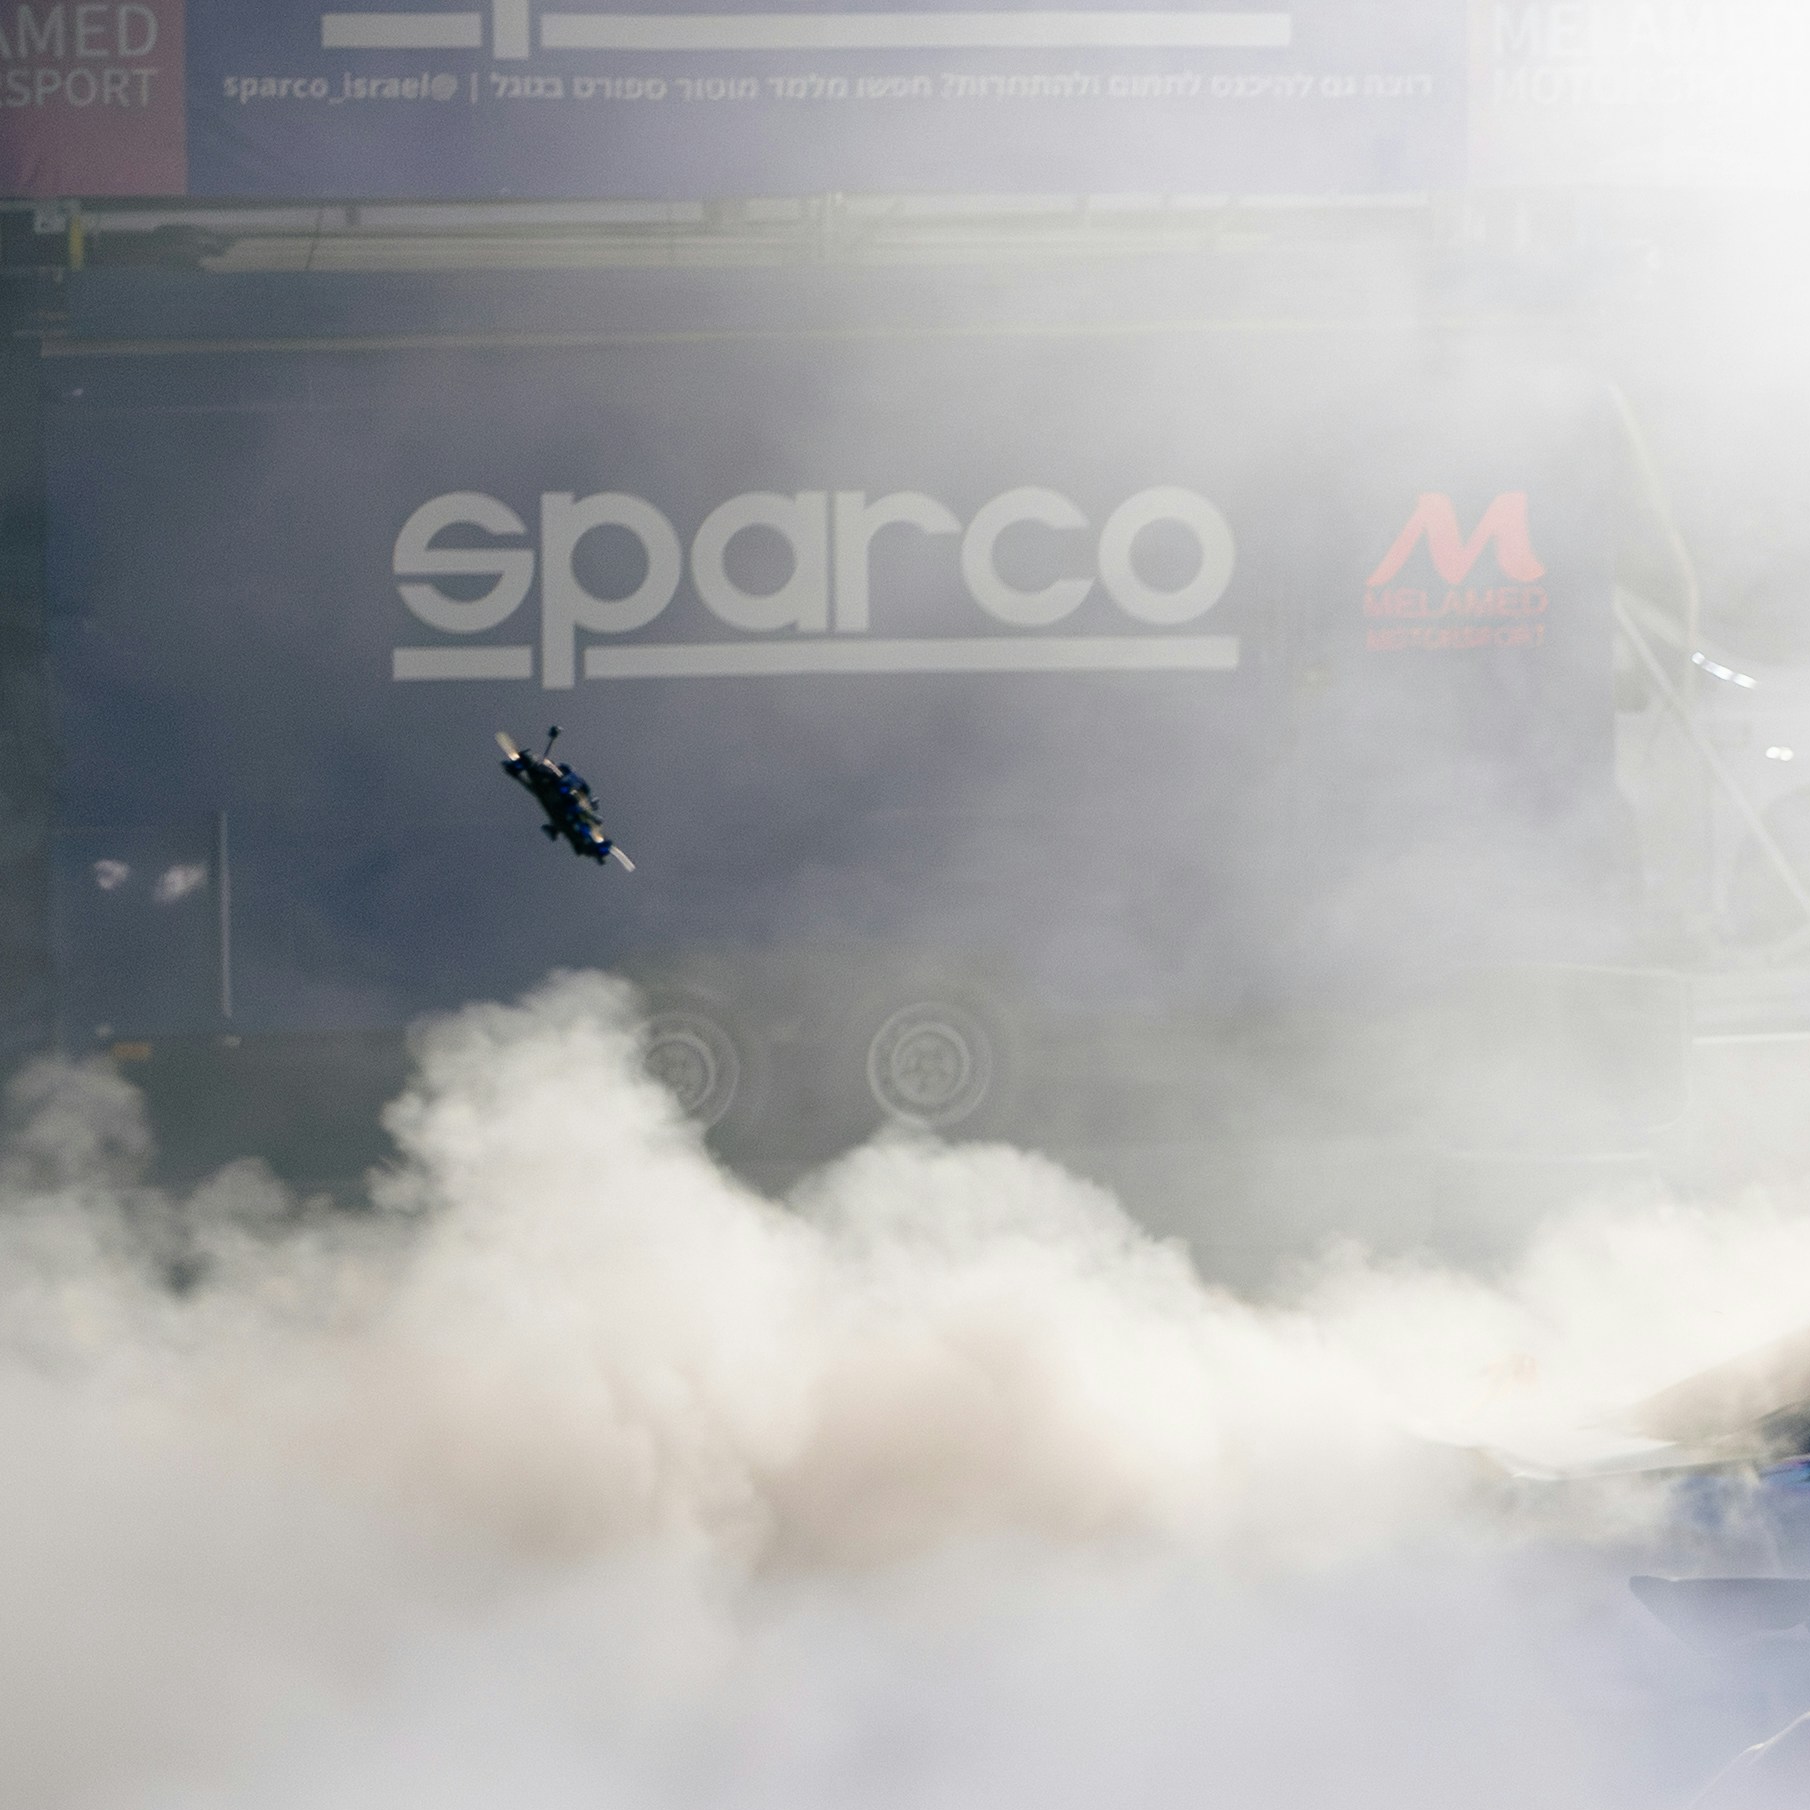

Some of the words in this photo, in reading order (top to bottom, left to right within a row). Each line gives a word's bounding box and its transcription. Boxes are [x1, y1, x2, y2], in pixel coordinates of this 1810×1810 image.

[0, 66, 159, 108] SPORT
[489, 71, 564, 99] בגוגל
[393, 485, 1236, 688] sparco
[1363, 586, 1548, 619] MELAMED
